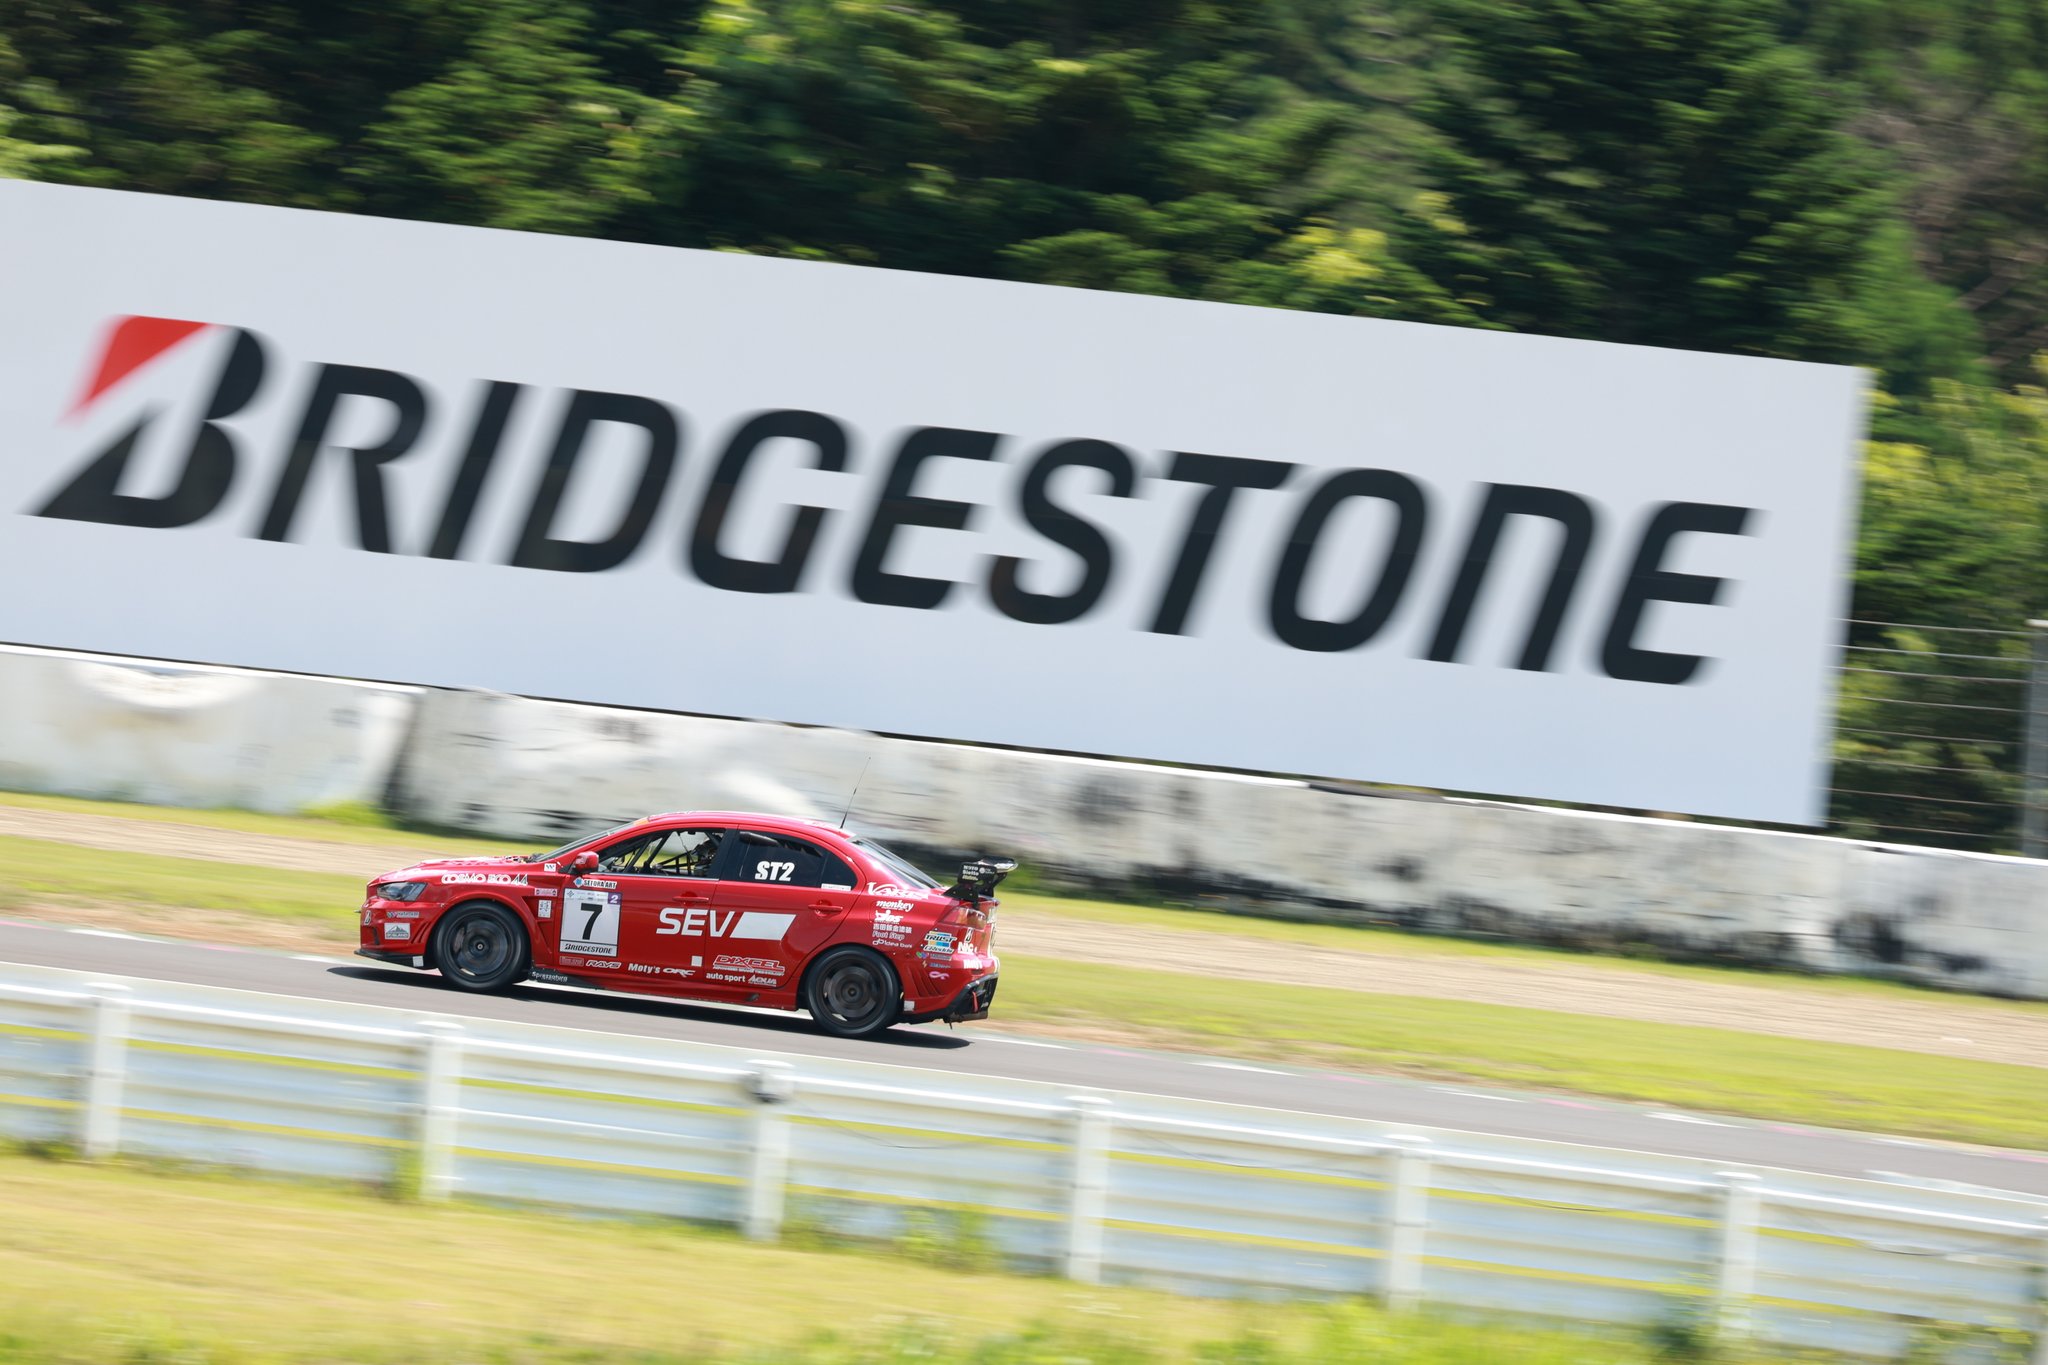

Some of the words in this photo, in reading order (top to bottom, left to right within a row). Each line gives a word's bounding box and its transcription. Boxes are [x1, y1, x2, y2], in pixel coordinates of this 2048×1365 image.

[20, 314, 1760, 685] BRIDGESTONE
[755, 861, 795, 881] ST2
[610, 894, 619, 904] 2
[876, 900, 914, 912] monkey
[581, 903, 603, 940] 7
[656, 907, 735, 937] SEV
[925, 934, 957, 943] TRUST
[564, 943, 613, 955] BRIDGESTONE
[586, 960, 621, 968] RAYS
[628, 963, 660, 974] Moty's
[724, 974, 745, 982] sport
